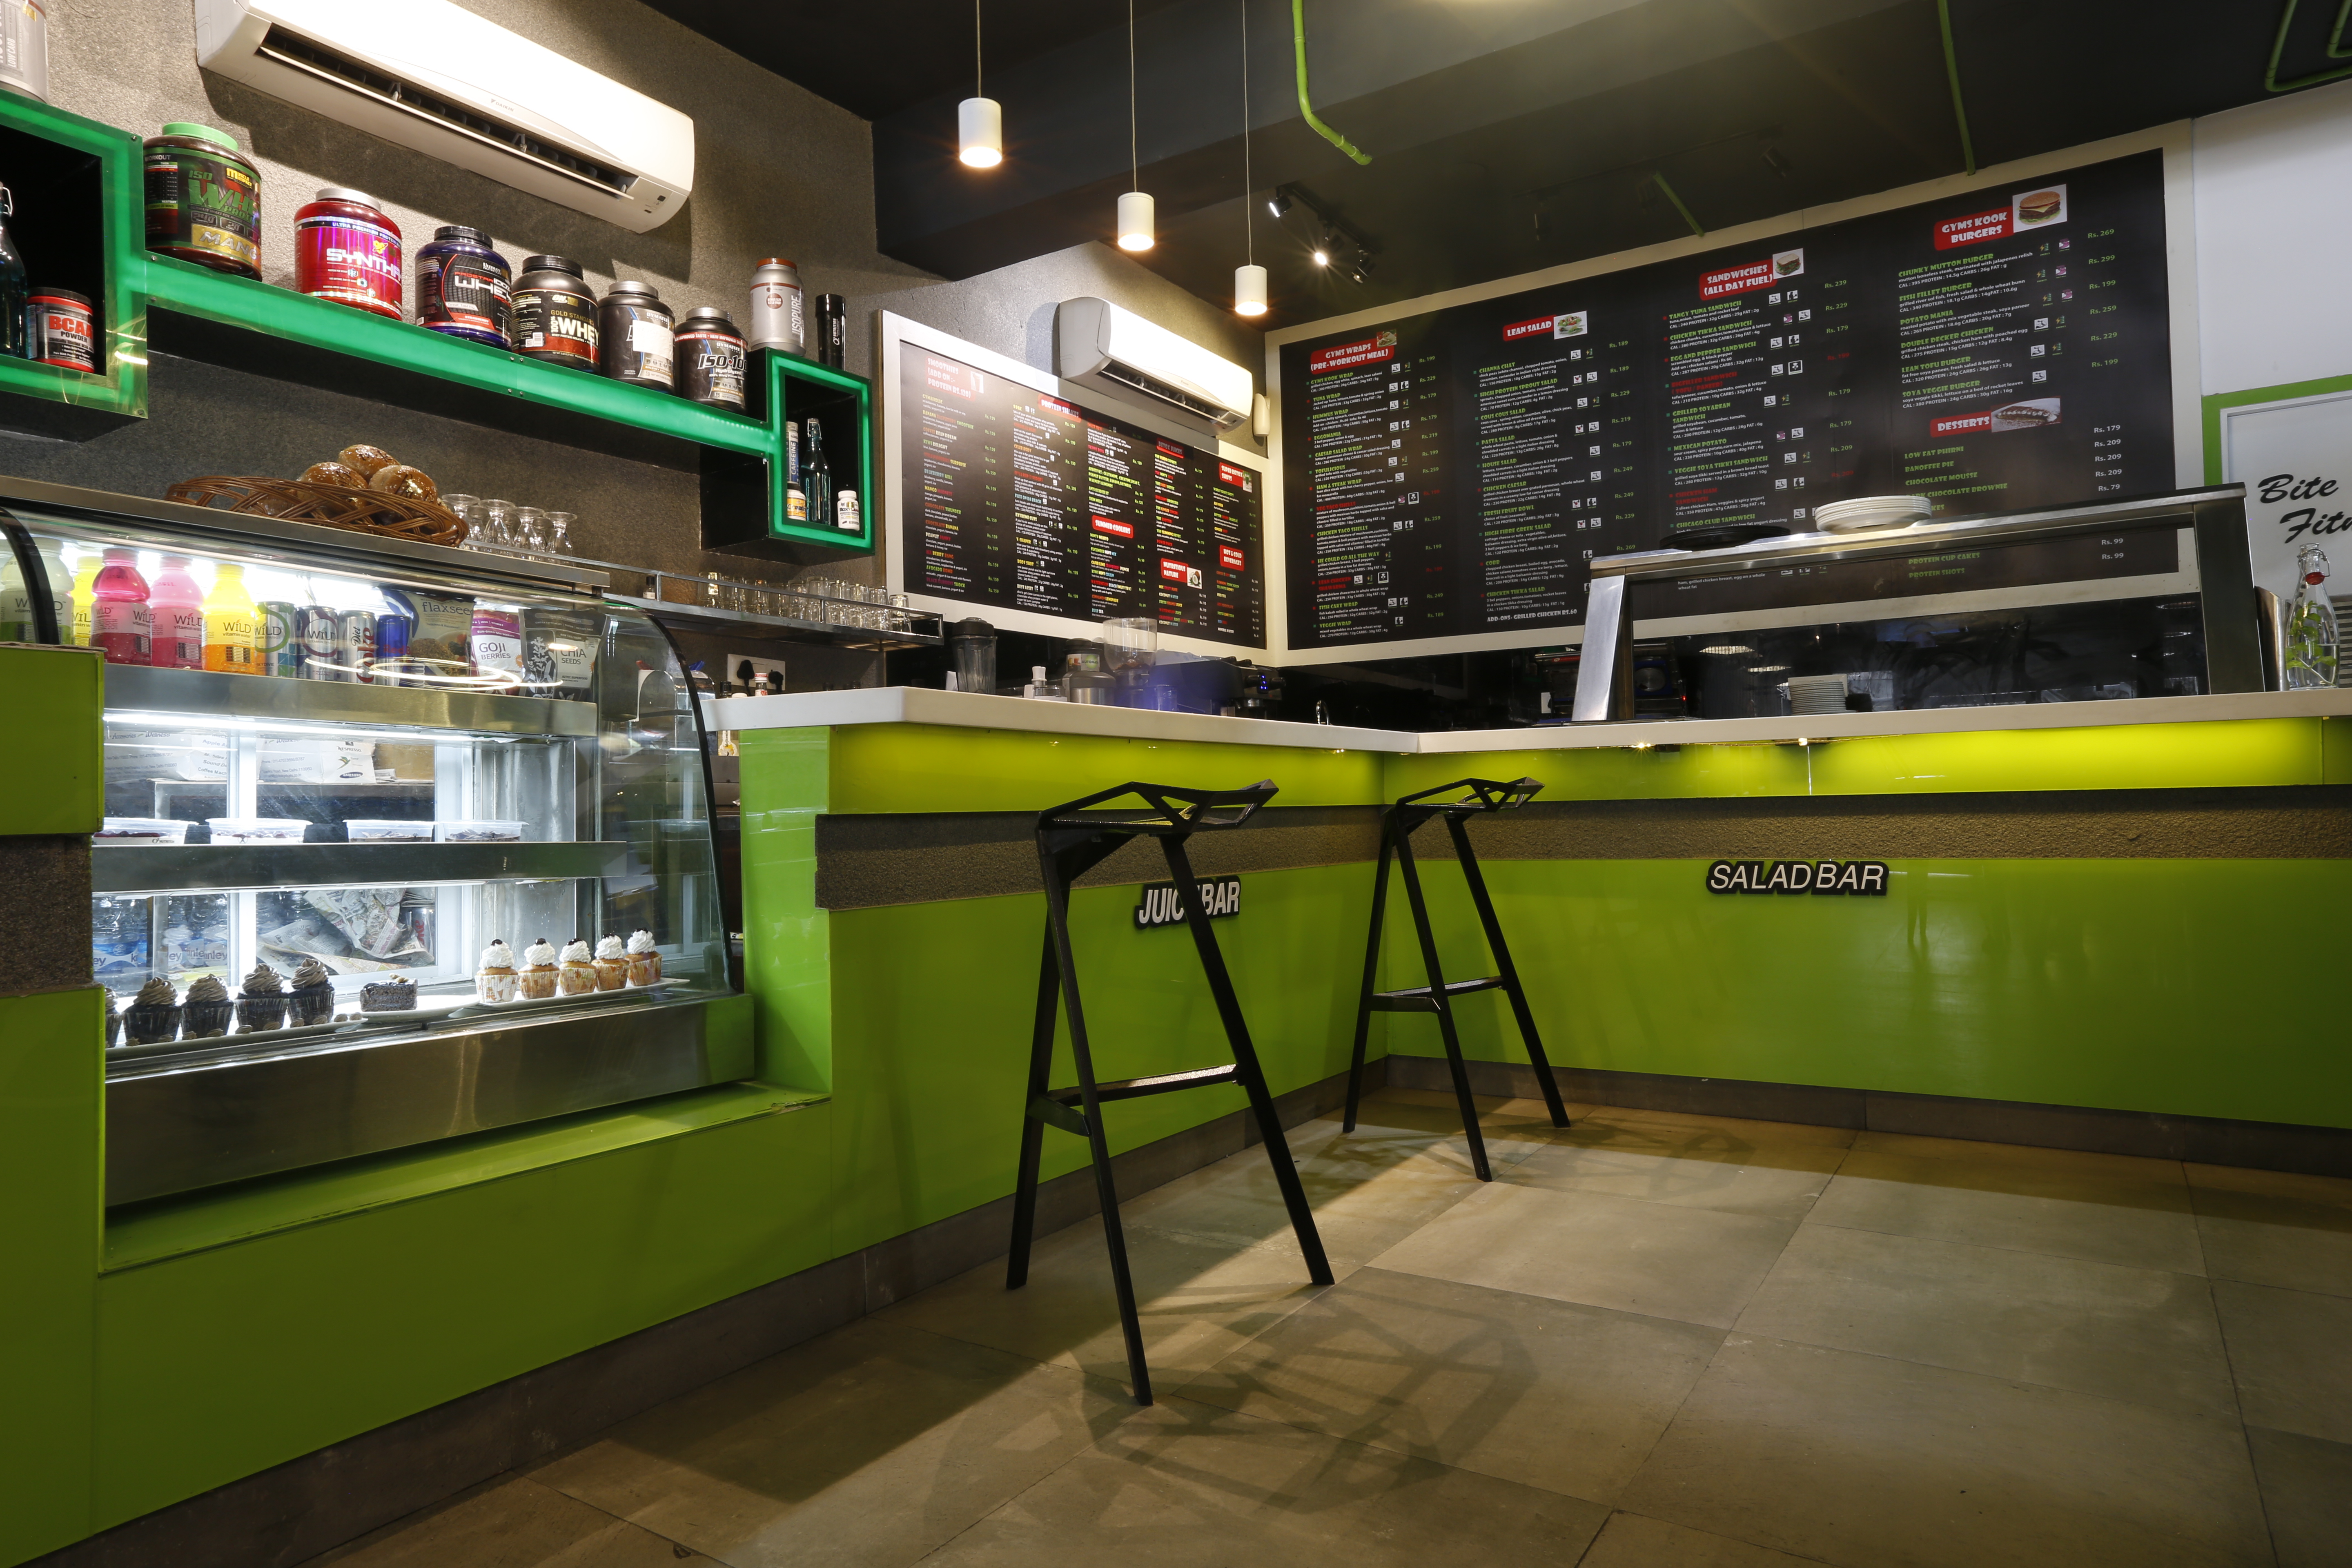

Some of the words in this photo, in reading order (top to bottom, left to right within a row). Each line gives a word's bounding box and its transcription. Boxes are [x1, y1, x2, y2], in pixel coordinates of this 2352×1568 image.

[7, 38, 16, 54] CARB
[189, 170, 212, 180] ISO
[1942, 219, 1972, 234] GYMS
[1975, 212, 2007, 227] KOOK
[353, 225, 378, 235] PREMIUM
[1951, 225, 2002, 243] BURGERS
[483, 263, 501, 272] ULTIMATE
[1899, 267, 1929, 277] CHUNKY
[1930, 260, 1961, 271] MUTTON
[1963, 254, 1993, 264] BURGER
[1954, 263, 1980, 272] marinated
[1993, 255, 2018, 264] jalapenos
[454, 272, 493, 282] PROSTAR
[1707, 265, 1768, 284] SANDWICHES
[1704, 283, 1724, 296] (ALL
[1725, 279, 1744, 291] DAY
[1746, 274, 1773, 287] FUEL)
[1669, 311, 1689, 319] TANGY
[1708, 301, 1742, 311] SANDWICH
[569, 312, 594, 325] STANDARD
[646, 312, 670, 323] DYMATIZE
[49, 316, 93, 339] BCAA
[557, 316, 599, 345] WHEY
[1507, 326, 1526, 336] LEAN
[1528, 321, 1552, 332] SALAD
[61, 331, 87, 343] POWDER
[1901, 339, 1929, 348] DOUBLE
[1931, 333, 1959, 343] DECKER
[1960, 327, 1993, 337] CHICKEN
[717, 342, 740, 351] DYMATIZE
[1325, 348, 1344, 359] GYMS
[1346, 343, 1371, 354] WRAPS
[928, 358, 958, 374] SMOOTHIES
[1310, 354, 1365, 371] (PRE-WORKOUT
[1367, 348, 1388, 359] MEAL)
[928, 378, 952, 392] PROTEIN
[1519, 382, 1540, 390] SPROUT
[1041, 399, 1062, 412] PROTEIN
[1938, 416, 1990, 432] DESSERTS
[2107, 424, 2120, 432] 179
[933, 441, 947, 450] DELIGHT
[1158, 441, 1170, 450] DETOX
[1171, 446, 1182, 454] JUICES
[1674, 442, 1701, 451] MEXICAN
[1702, 439, 1727, 447] POTATO
[1937, 445, 1964, 455] PHIRNI
[1905, 462, 1940, 472] BANOFFEE
[1222, 473, 1232, 481] SHOTS
[2258, 474, 2339, 503] Bite
[1095, 520, 1112, 530] SUMMER
[1113, 524, 1131, 534] COOLERS
[1224, 557, 1241, 566] BEVERAGES
[1909, 556, 1940, 565] PROTEIN
[1957, 552, 1980, 561] CAKES
[1163, 561, 1186, 572] NUTRITIOUS
[1164, 570, 1178, 578] NATURE
[351, 626, 361, 646] Diet
[479, 642, 506, 653] GOJI
[1711, 864, 1811, 889] SALAD
[1816, 864, 1883, 889] BAR
[1139, 886, 1200, 923] JUIC
[1203, 882, 1240, 915] BAR
